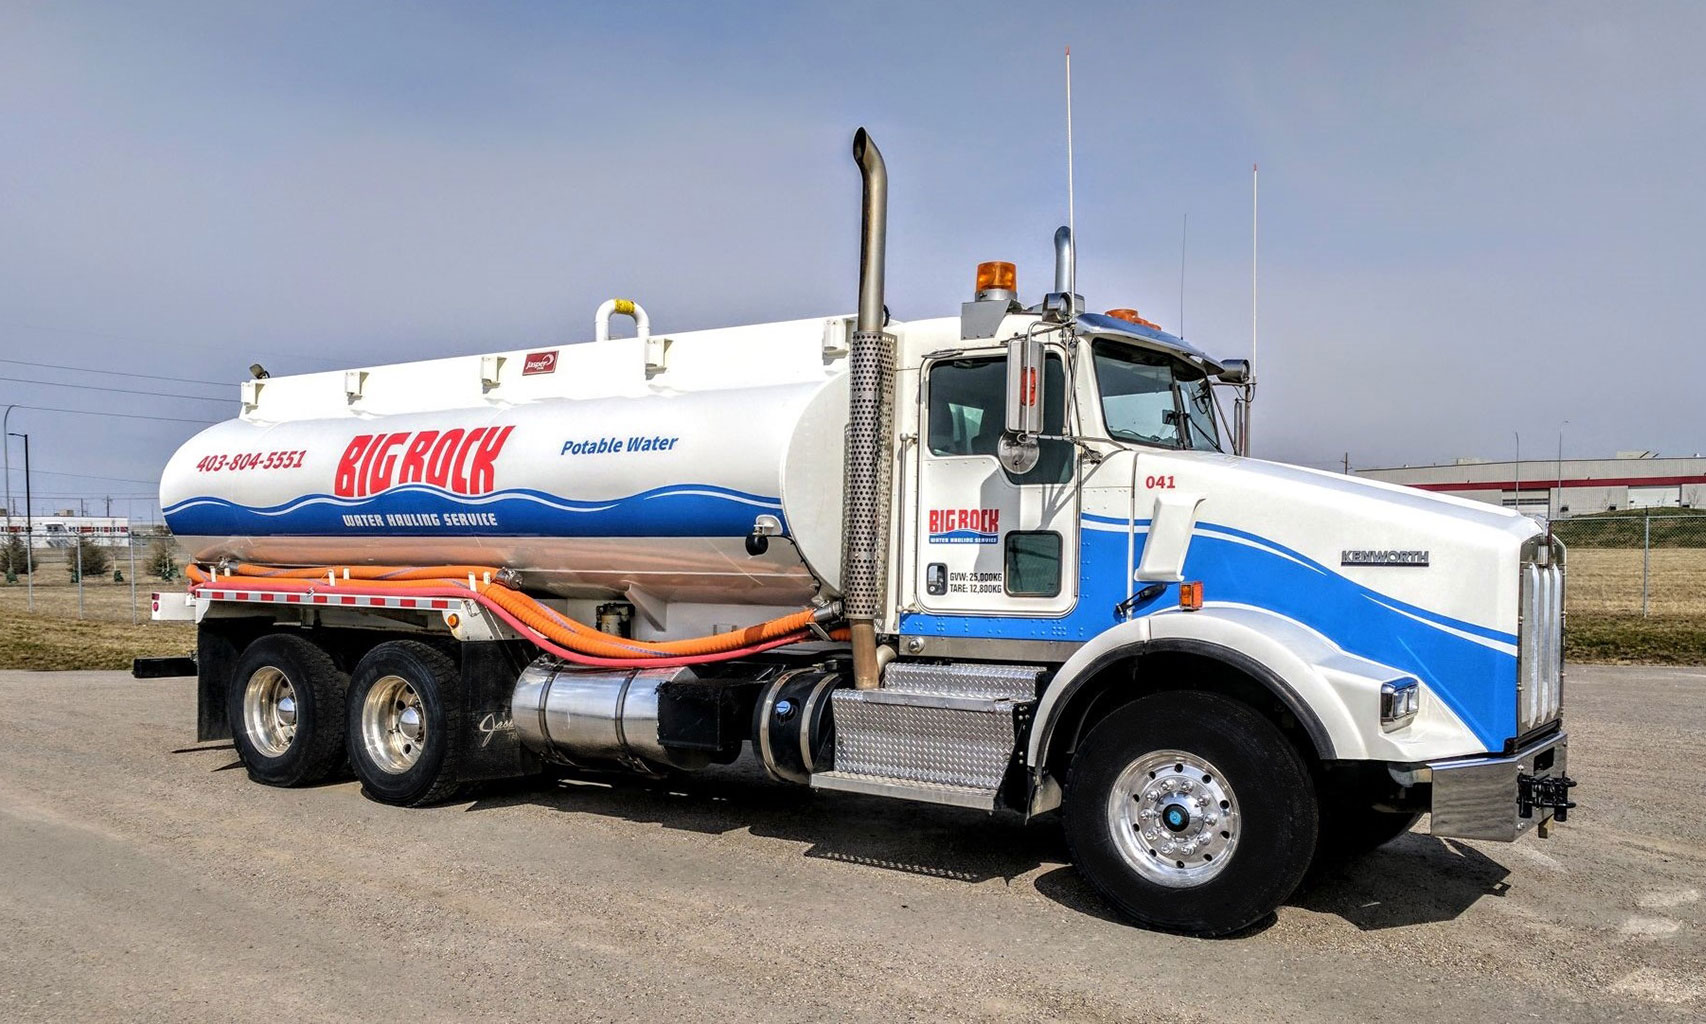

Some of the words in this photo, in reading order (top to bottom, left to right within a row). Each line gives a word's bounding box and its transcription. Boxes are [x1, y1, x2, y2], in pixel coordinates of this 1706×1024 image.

[561, 437, 623, 456] Potable
[626, 436, 679, 452] Water
[196, 450, 307, 472] 403-804-5551
[1146, 475, 1176, 489] 041
[342, 514, 384, 527] WATER
[387, 513, 440, 526] HAULING
[443, 512, 498, 526] SERVICE
[1341, 550, 1430, 563] KENWORTH
[950, 572, 969, 582] GVW:
[969, 572, 1003, 583] 25,000KG
[950, 583, 969, 593] TARE:
[969, 584, 1003, 594] 12,800KG
